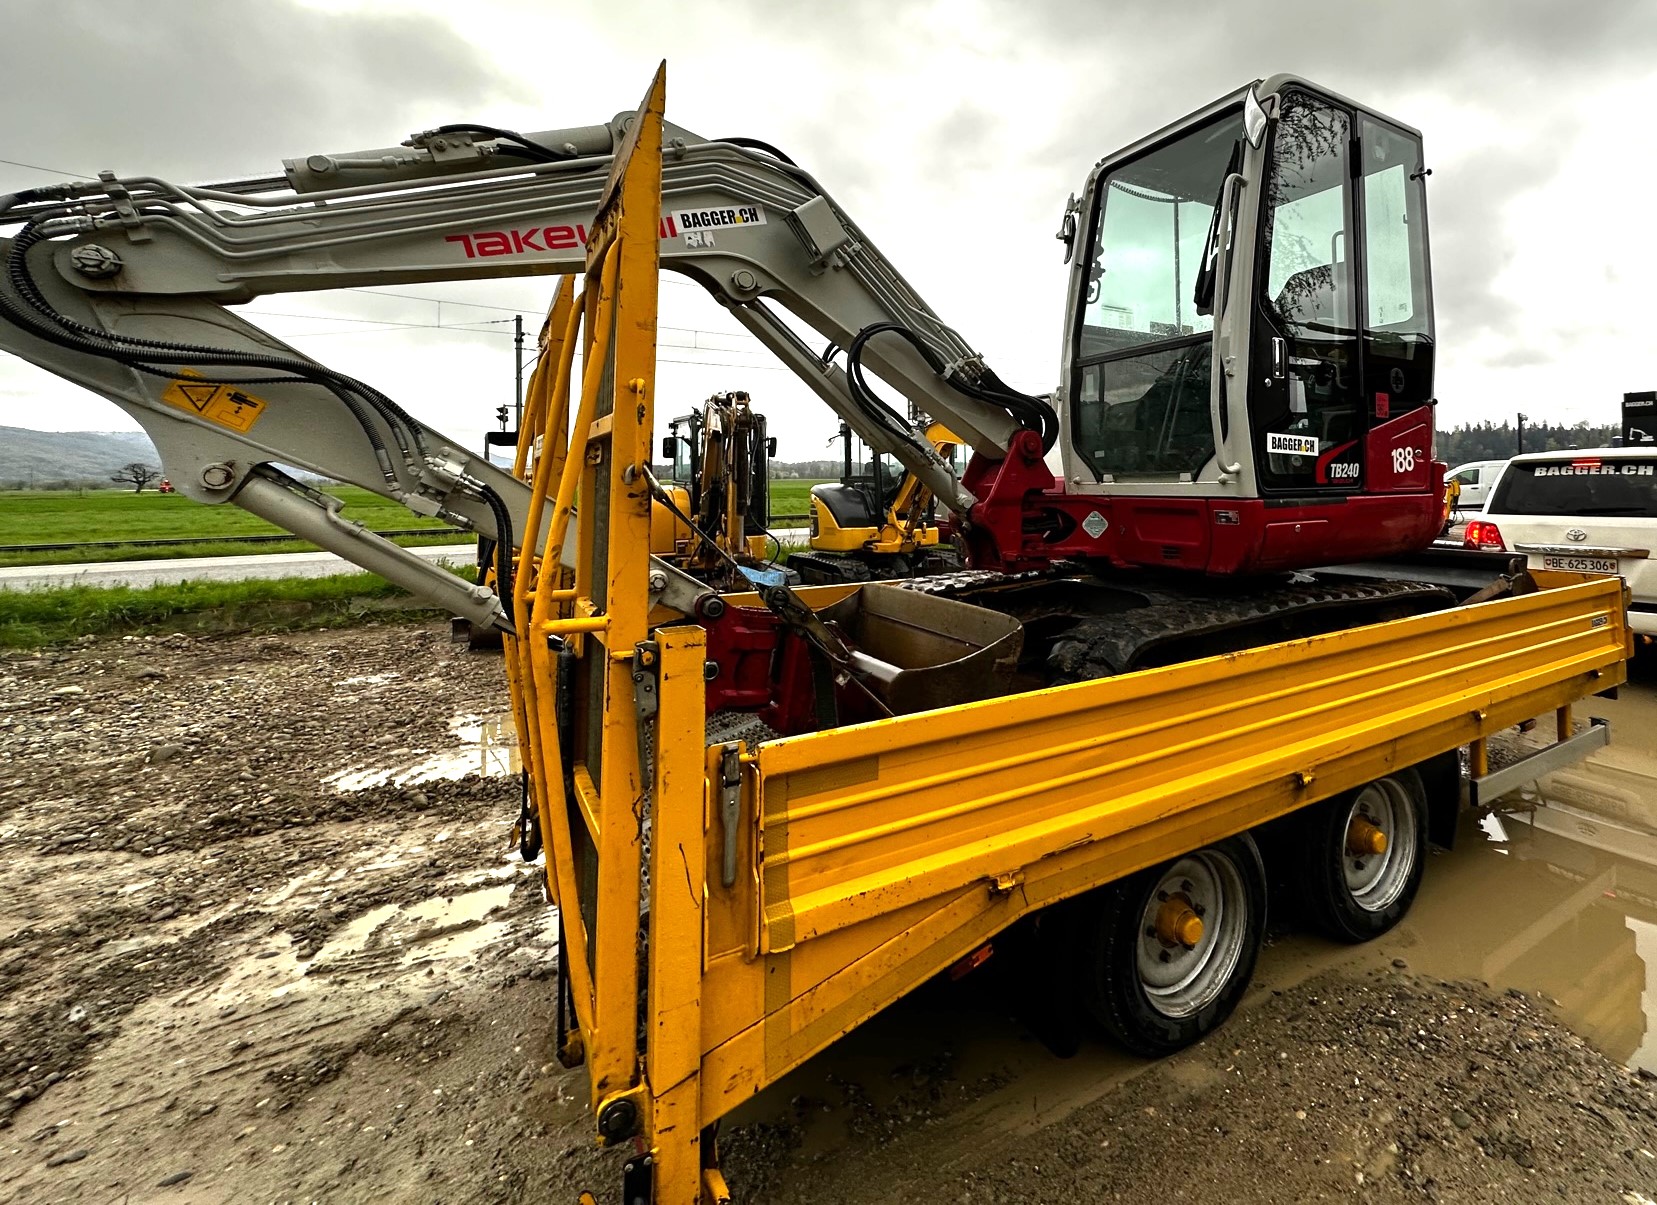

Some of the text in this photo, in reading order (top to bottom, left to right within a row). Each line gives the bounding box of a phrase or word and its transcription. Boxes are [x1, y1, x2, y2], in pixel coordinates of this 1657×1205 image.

[680, 207, 759, 228] BAGGER.CH
[1271, 437, 1315, 453] BAGGER.CH
[1392, 447, 1414, 473] 188
[1331, 463, 1359, 477] TB240
[1534, 465, 1654, 476] BAGGER.CH
